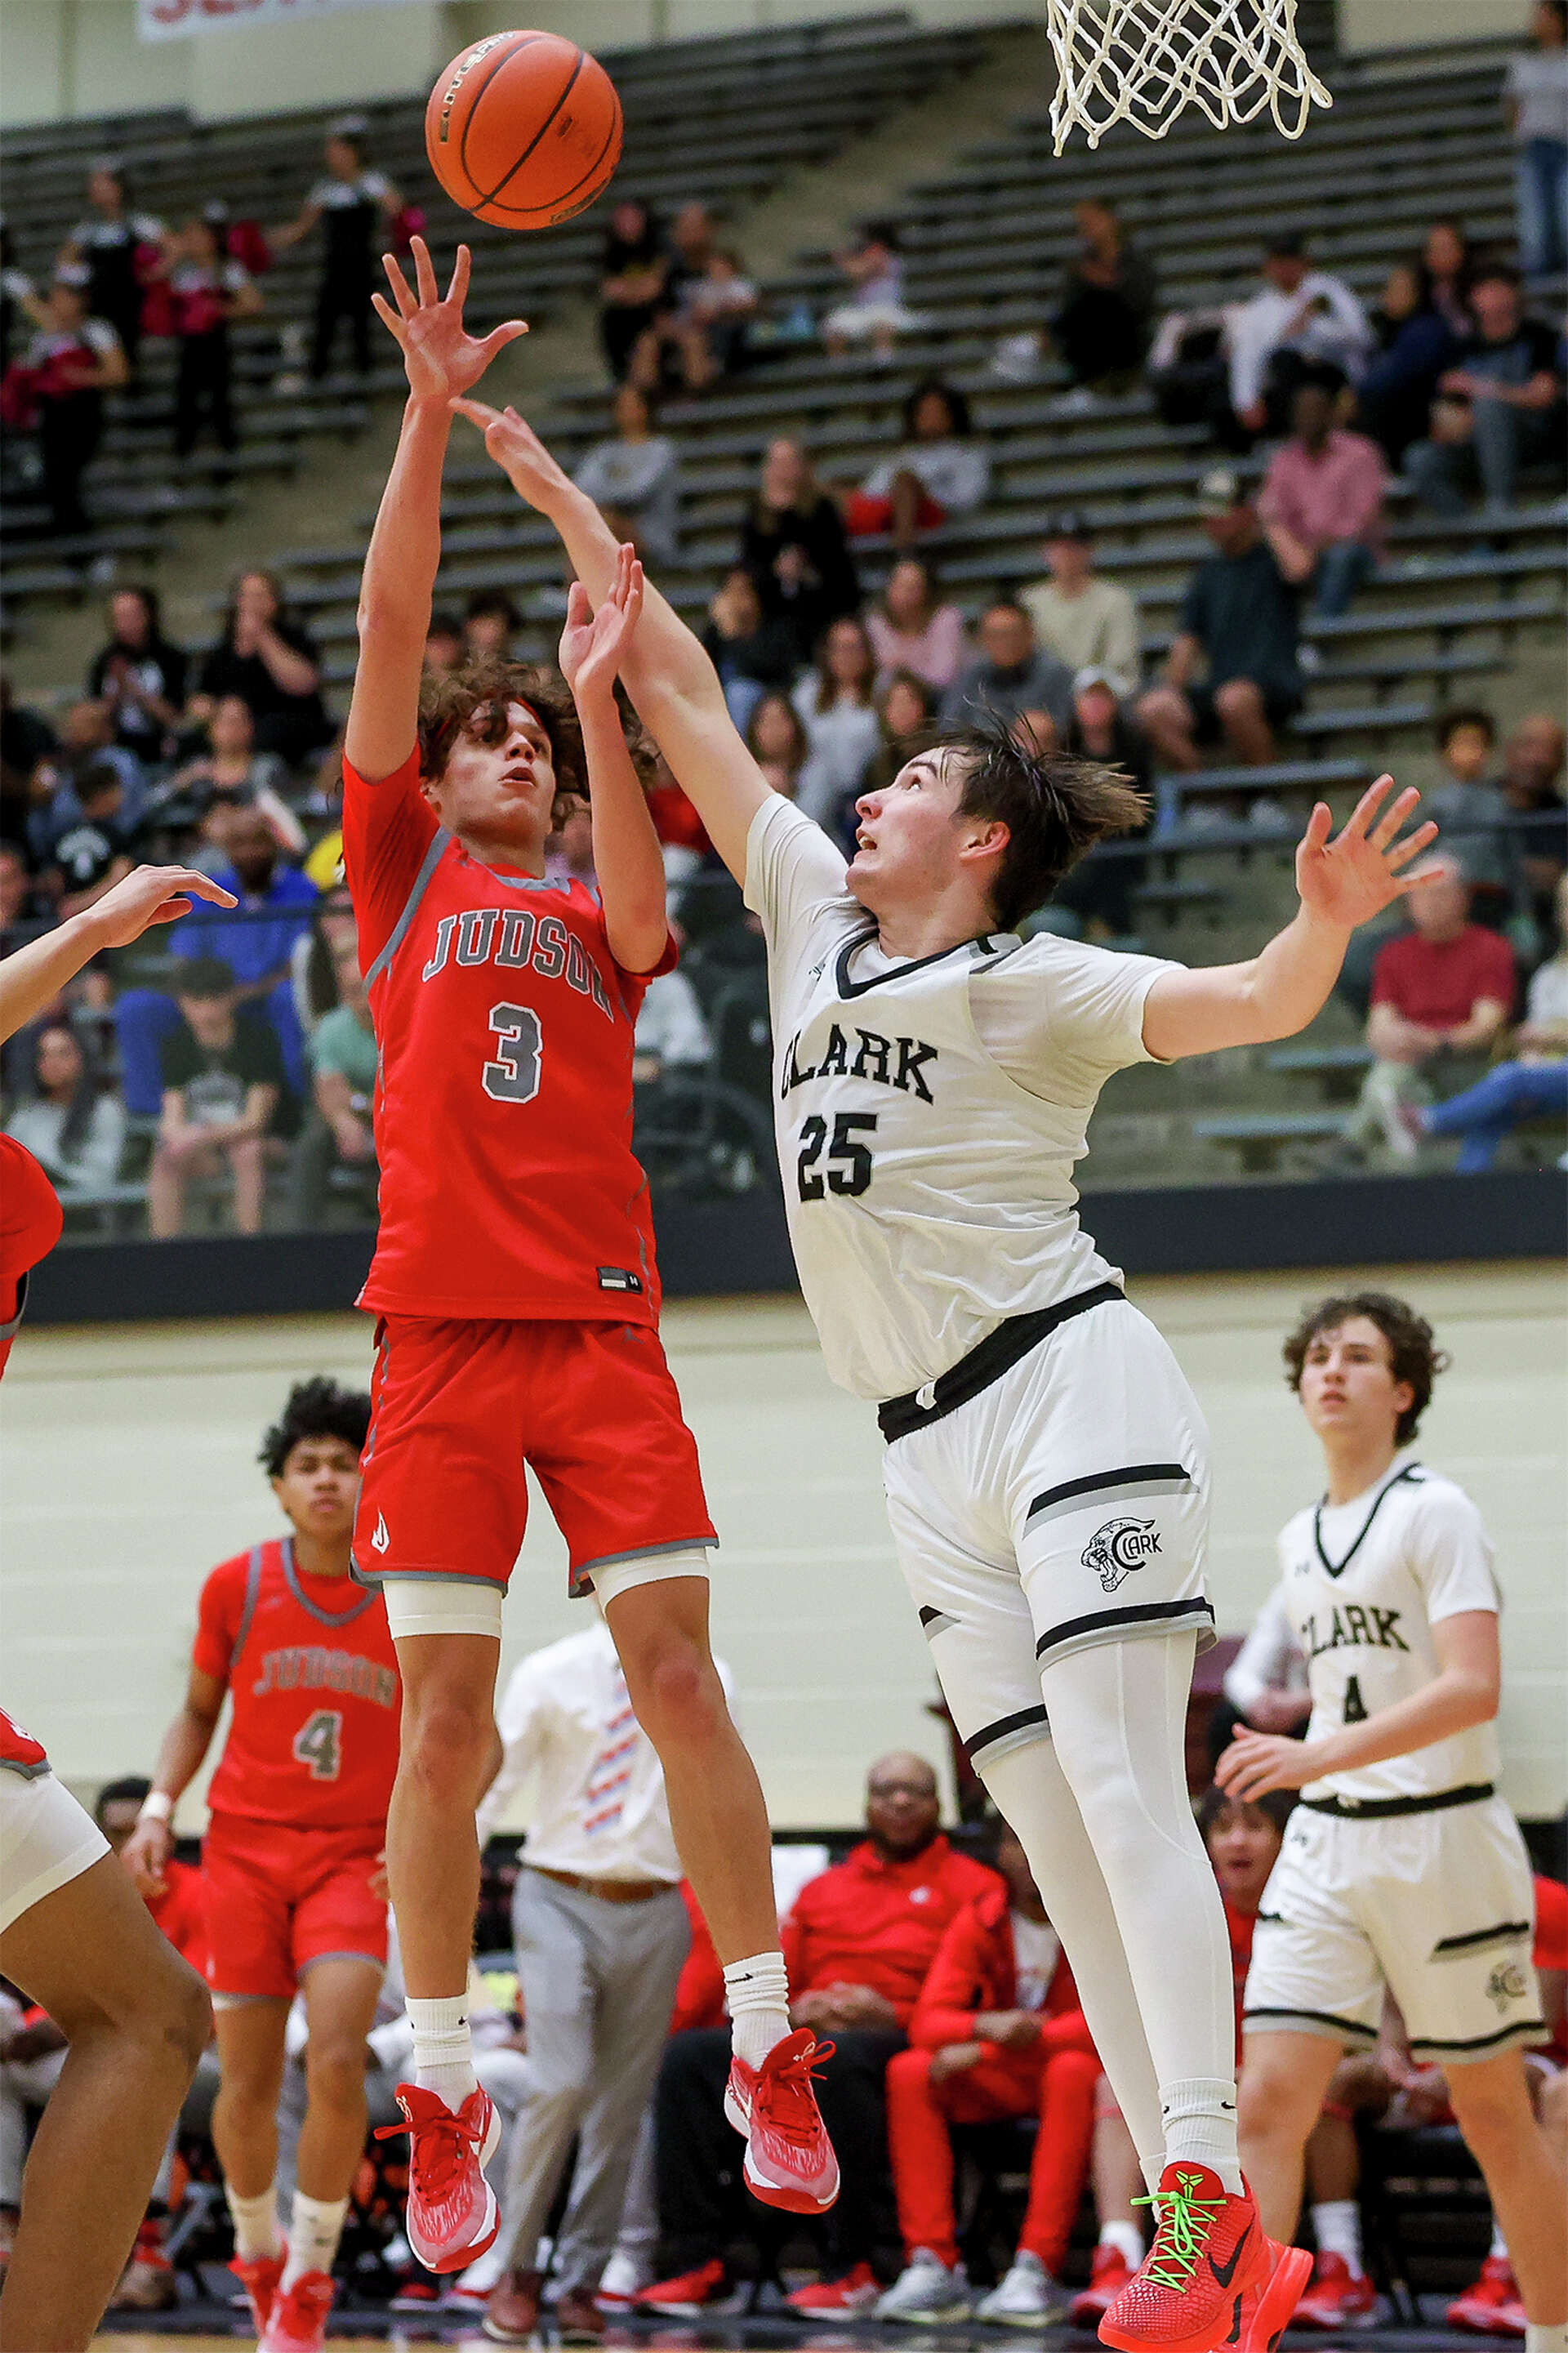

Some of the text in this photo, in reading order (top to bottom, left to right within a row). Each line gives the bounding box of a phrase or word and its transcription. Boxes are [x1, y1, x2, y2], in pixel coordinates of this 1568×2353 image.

[422, 908, 614, 1023] JUDSON
[482, 1000, 543, 1104] 3
[782, 1023, 938, 1106] CLARK
[797, 1112, 878, 1202] 25
[1111, 1526, 1163, 1571] CLARK
[1301, 1605, 1410, 1656] LARK
[1343, 1674, 1370, 1726] 4
[293, 1709, 343, 1782] 4
